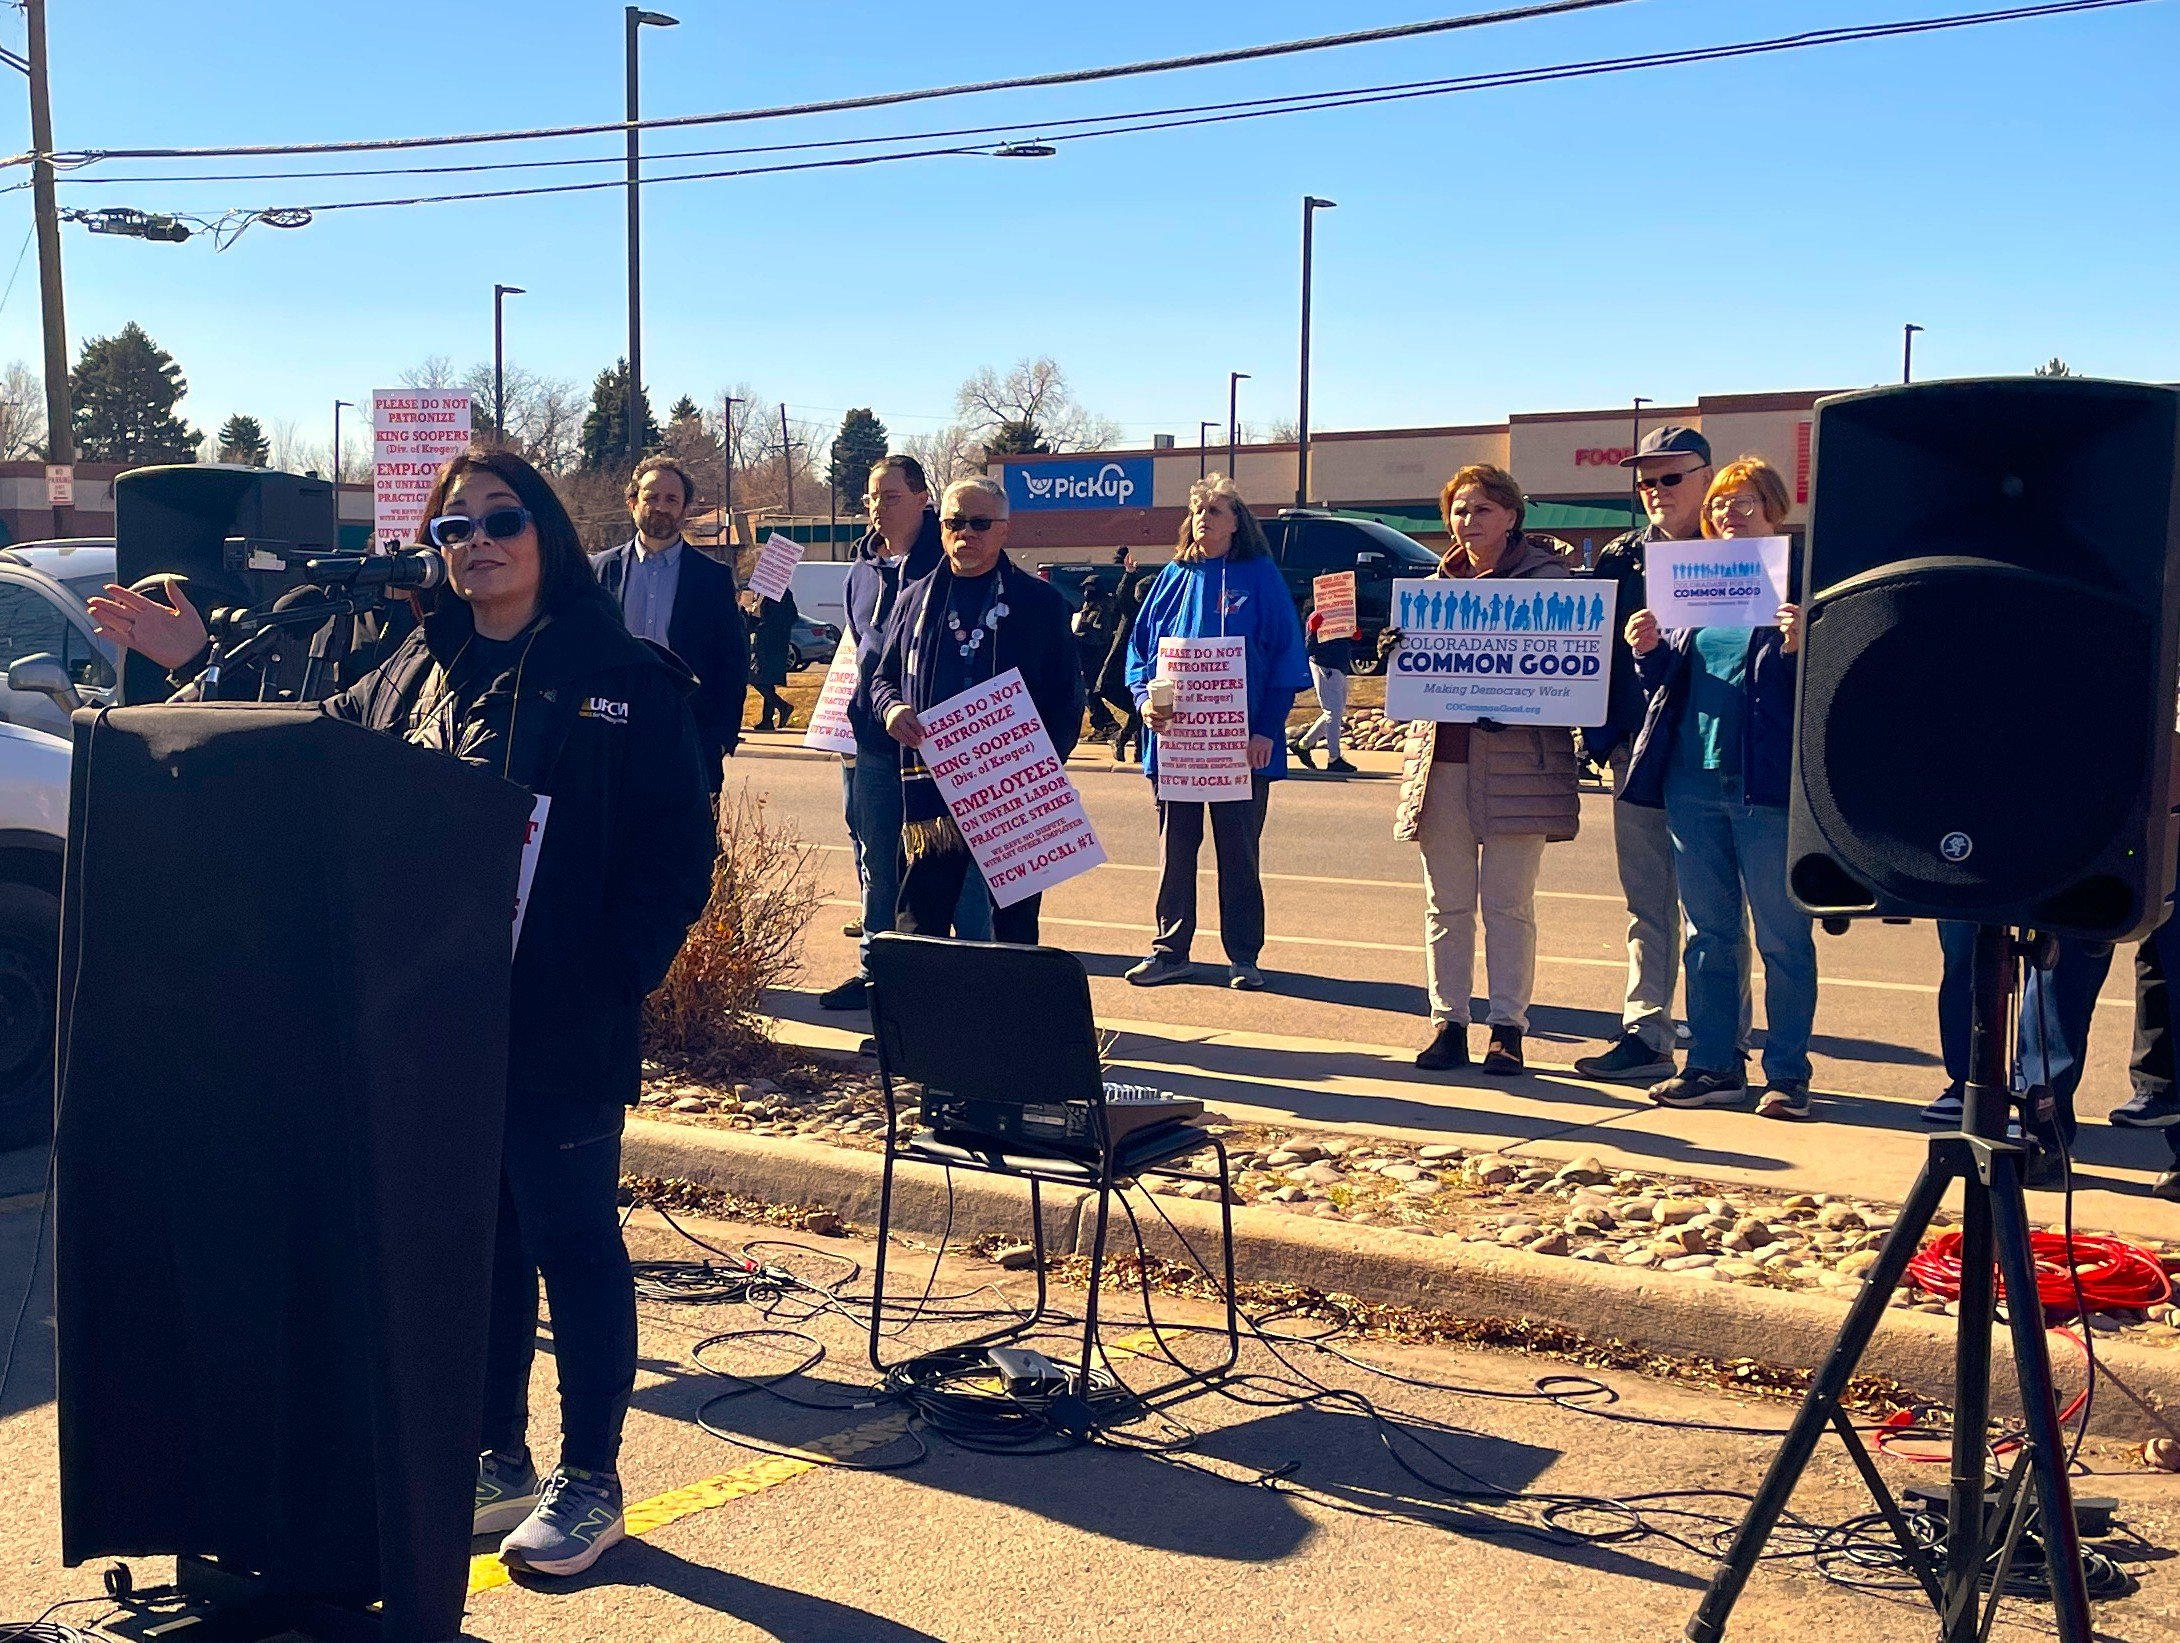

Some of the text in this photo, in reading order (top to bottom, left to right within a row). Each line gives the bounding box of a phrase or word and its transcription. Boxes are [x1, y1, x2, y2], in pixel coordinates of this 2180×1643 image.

[376, 399, 468, 410] PLEASE DO NOT
[389, 413, 455, 422] PATRONIZE
[376, 431, 468, 442] KING SOOPERS
[386, 444, 458, 455] (Div. of Kroger)
[377, 463, 442, 476] EMPLOY
[377, 481, 392, 489] ON
[378, 528, 411, 538] UFCW
[1674, 587, 1760, 597] COMMON GOOD
[1399, 637, 1600, 653] COLORADANS FOR THE
[1160, 647, 1242, 659] PLEASE DO NOT
[1168, 662, 1230, 672] PATRONIZE
[1397, 651, 1600, 675] COMMON GOOD
[1187, 679, 1244, 690] SOOPERS
[1423, 683, 1572, 697] Making Democracy Work
[1196, 693, 1234, 704] Kroger)
[924, 680, 1023, 739] LEASE DO NOT
[1445, 703, 1541, 714] COCommonGood.org
[933, 704, 1016, 752] PATRONIZE
[1173, 729, 1208, 737] UNFAIR
[1210, 728, 1246, 737] LABOR
[931, 718, 1041, 780] KING SOOPERS
[1160, 741, 1247, 750] PRACTICE STRIKE
[950, 740, 1036, 790] (Div. of Kroger)
[1160, 774, 1248, 786] UFCW LOCAL #7
[951, 756, 1060, 818] EMPLOYEES
[961, 776, 1068, 834] ON UNFAIR LABOR
[969, 792, 1075, 848] PRACTICE STRIKE
[1023, 833, 1034, 841] NO
[988, 833, 1095, 889] UFCW LOCAL #7
